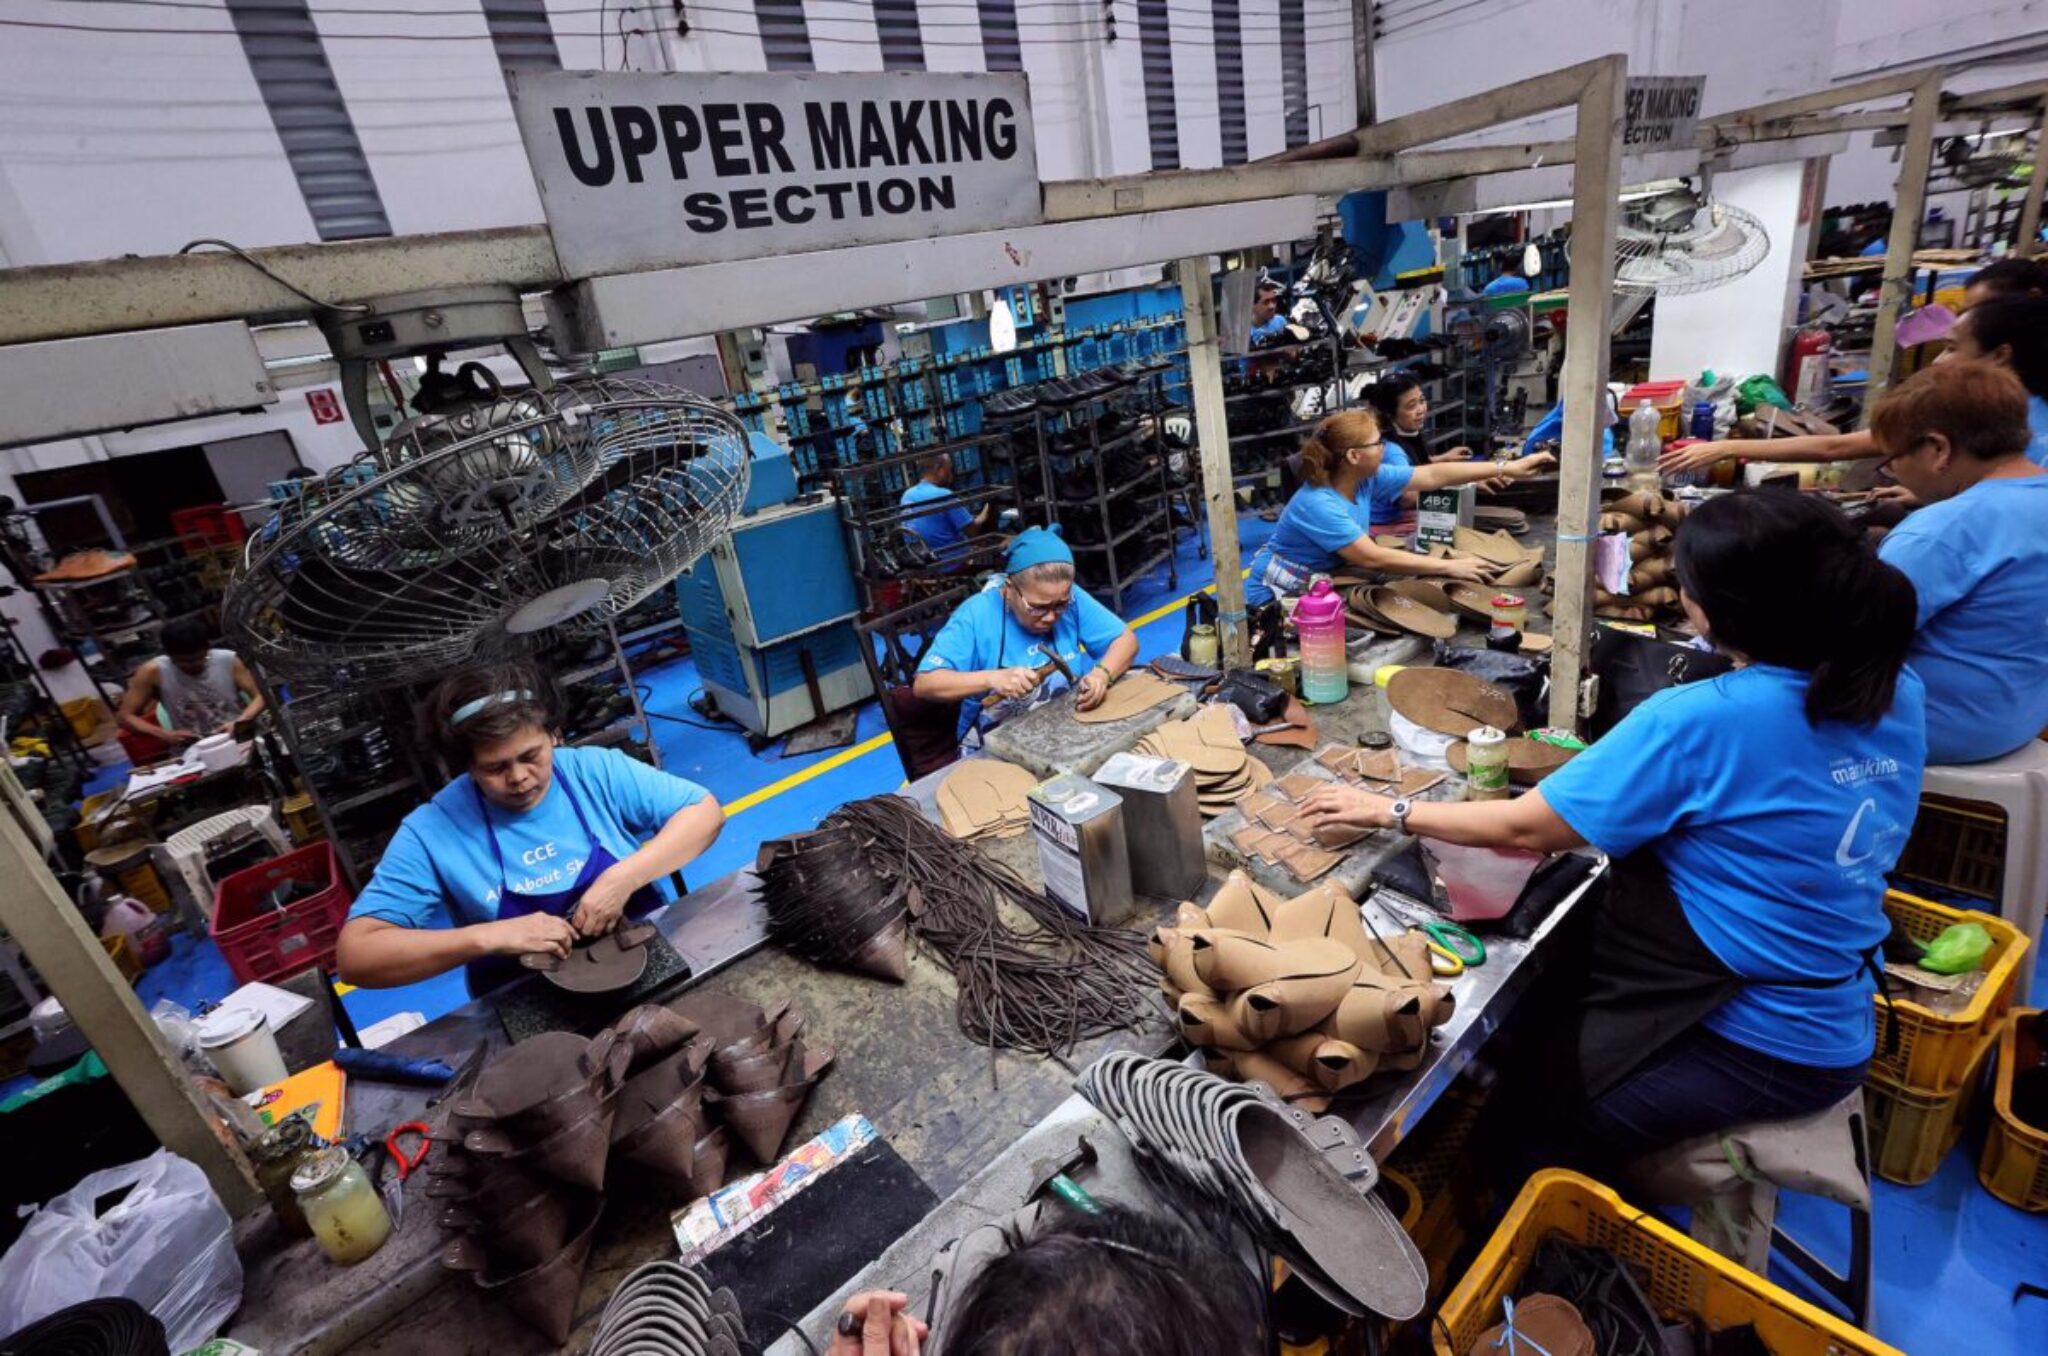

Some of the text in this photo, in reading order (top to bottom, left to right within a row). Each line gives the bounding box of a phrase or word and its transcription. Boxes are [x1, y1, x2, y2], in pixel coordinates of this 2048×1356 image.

[1645, 87, 1697, 119] MAKING
[552, 97, 1018, 188] UPPER MAKING
[683, 175, 957, 234] SECTION
[1423, 495, 1451, 506] ABC
[522, 842, 558, 866] CCE
[514, 868, 562, 893] About
